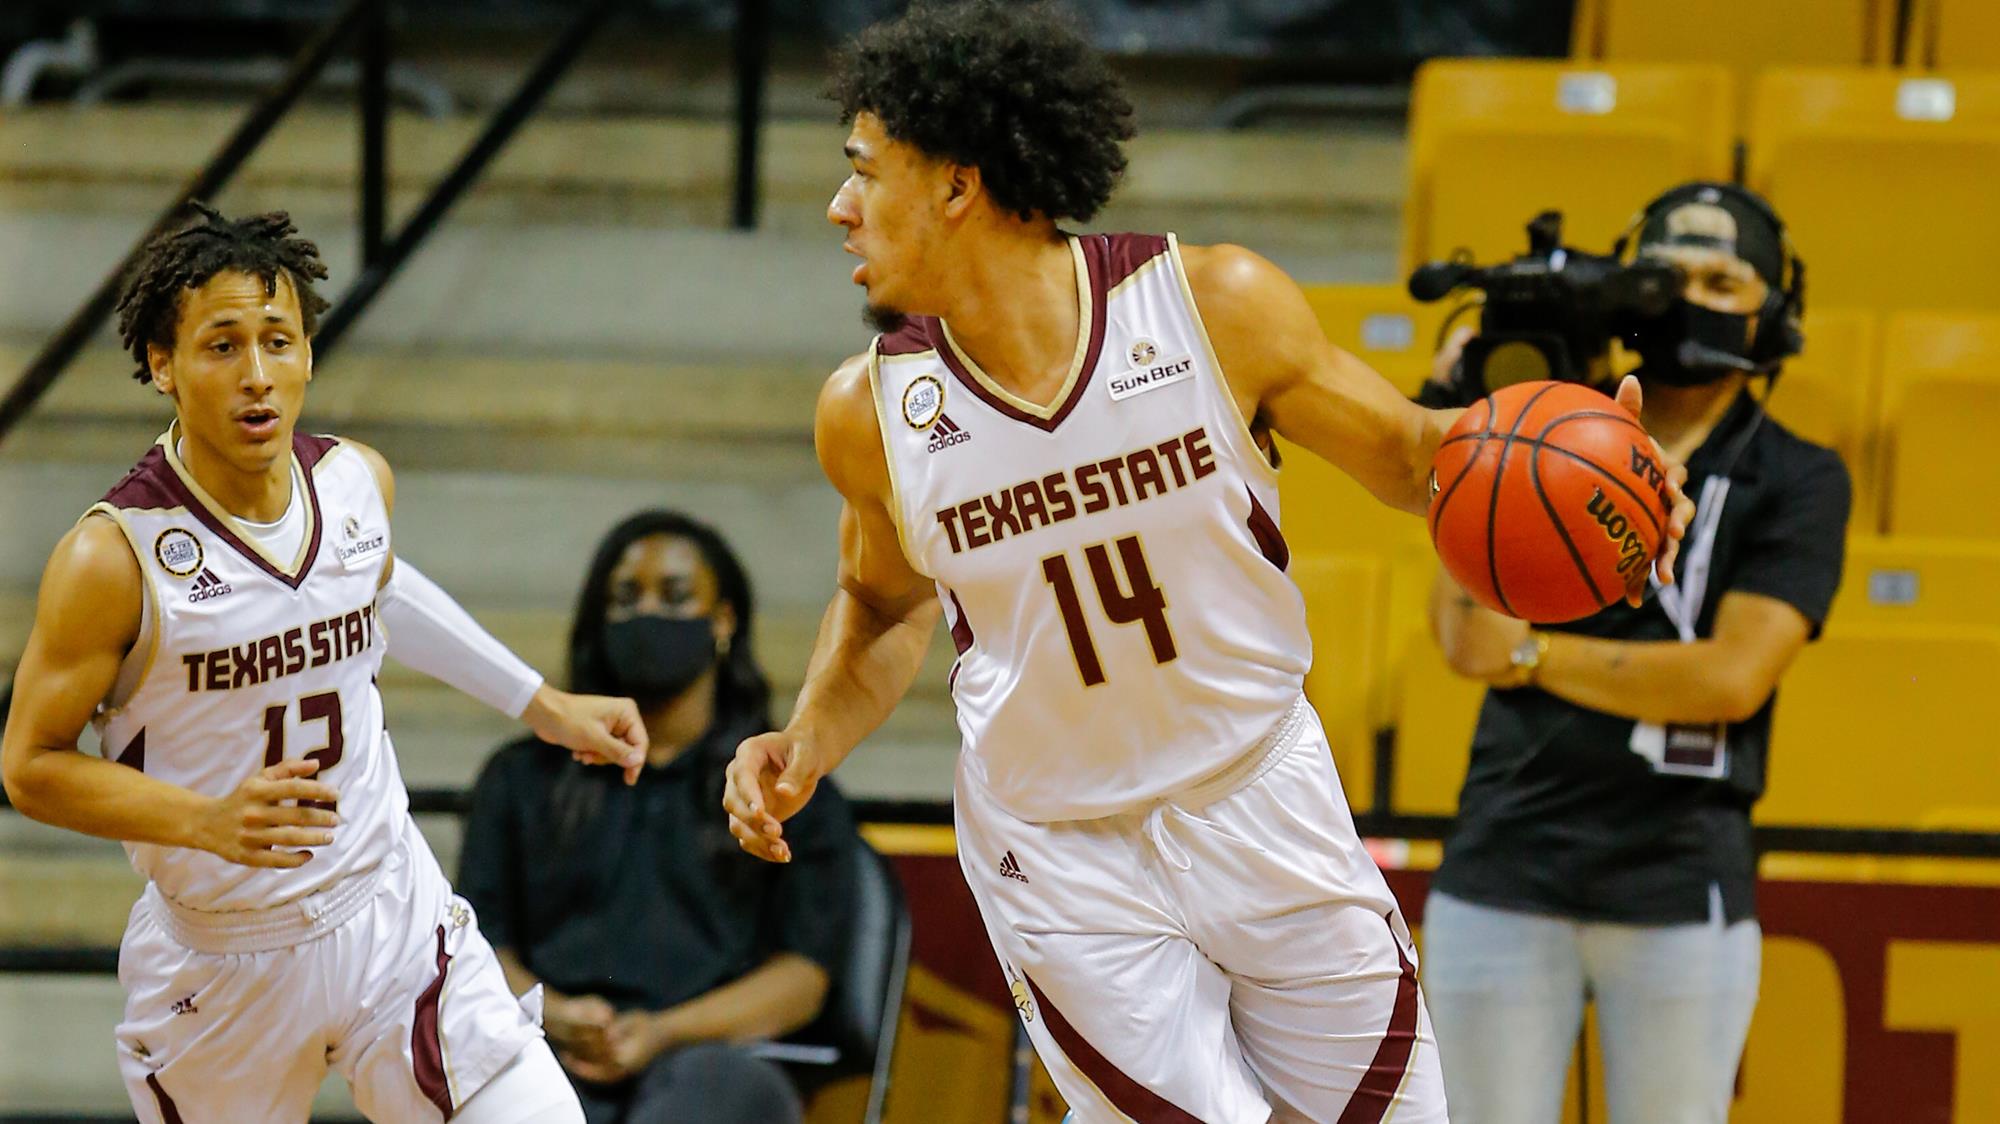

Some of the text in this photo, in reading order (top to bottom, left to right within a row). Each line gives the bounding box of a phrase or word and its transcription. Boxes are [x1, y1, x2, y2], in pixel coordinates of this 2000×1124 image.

[928, 432, 971, 453] adidas
[936, 427, 1217, 554] TEXAS STATE
[188, 584, 231, 603] adidas
[1041, 535, 1178, 687] 14
[182, 599, 376, 692] TEXAS STAT
